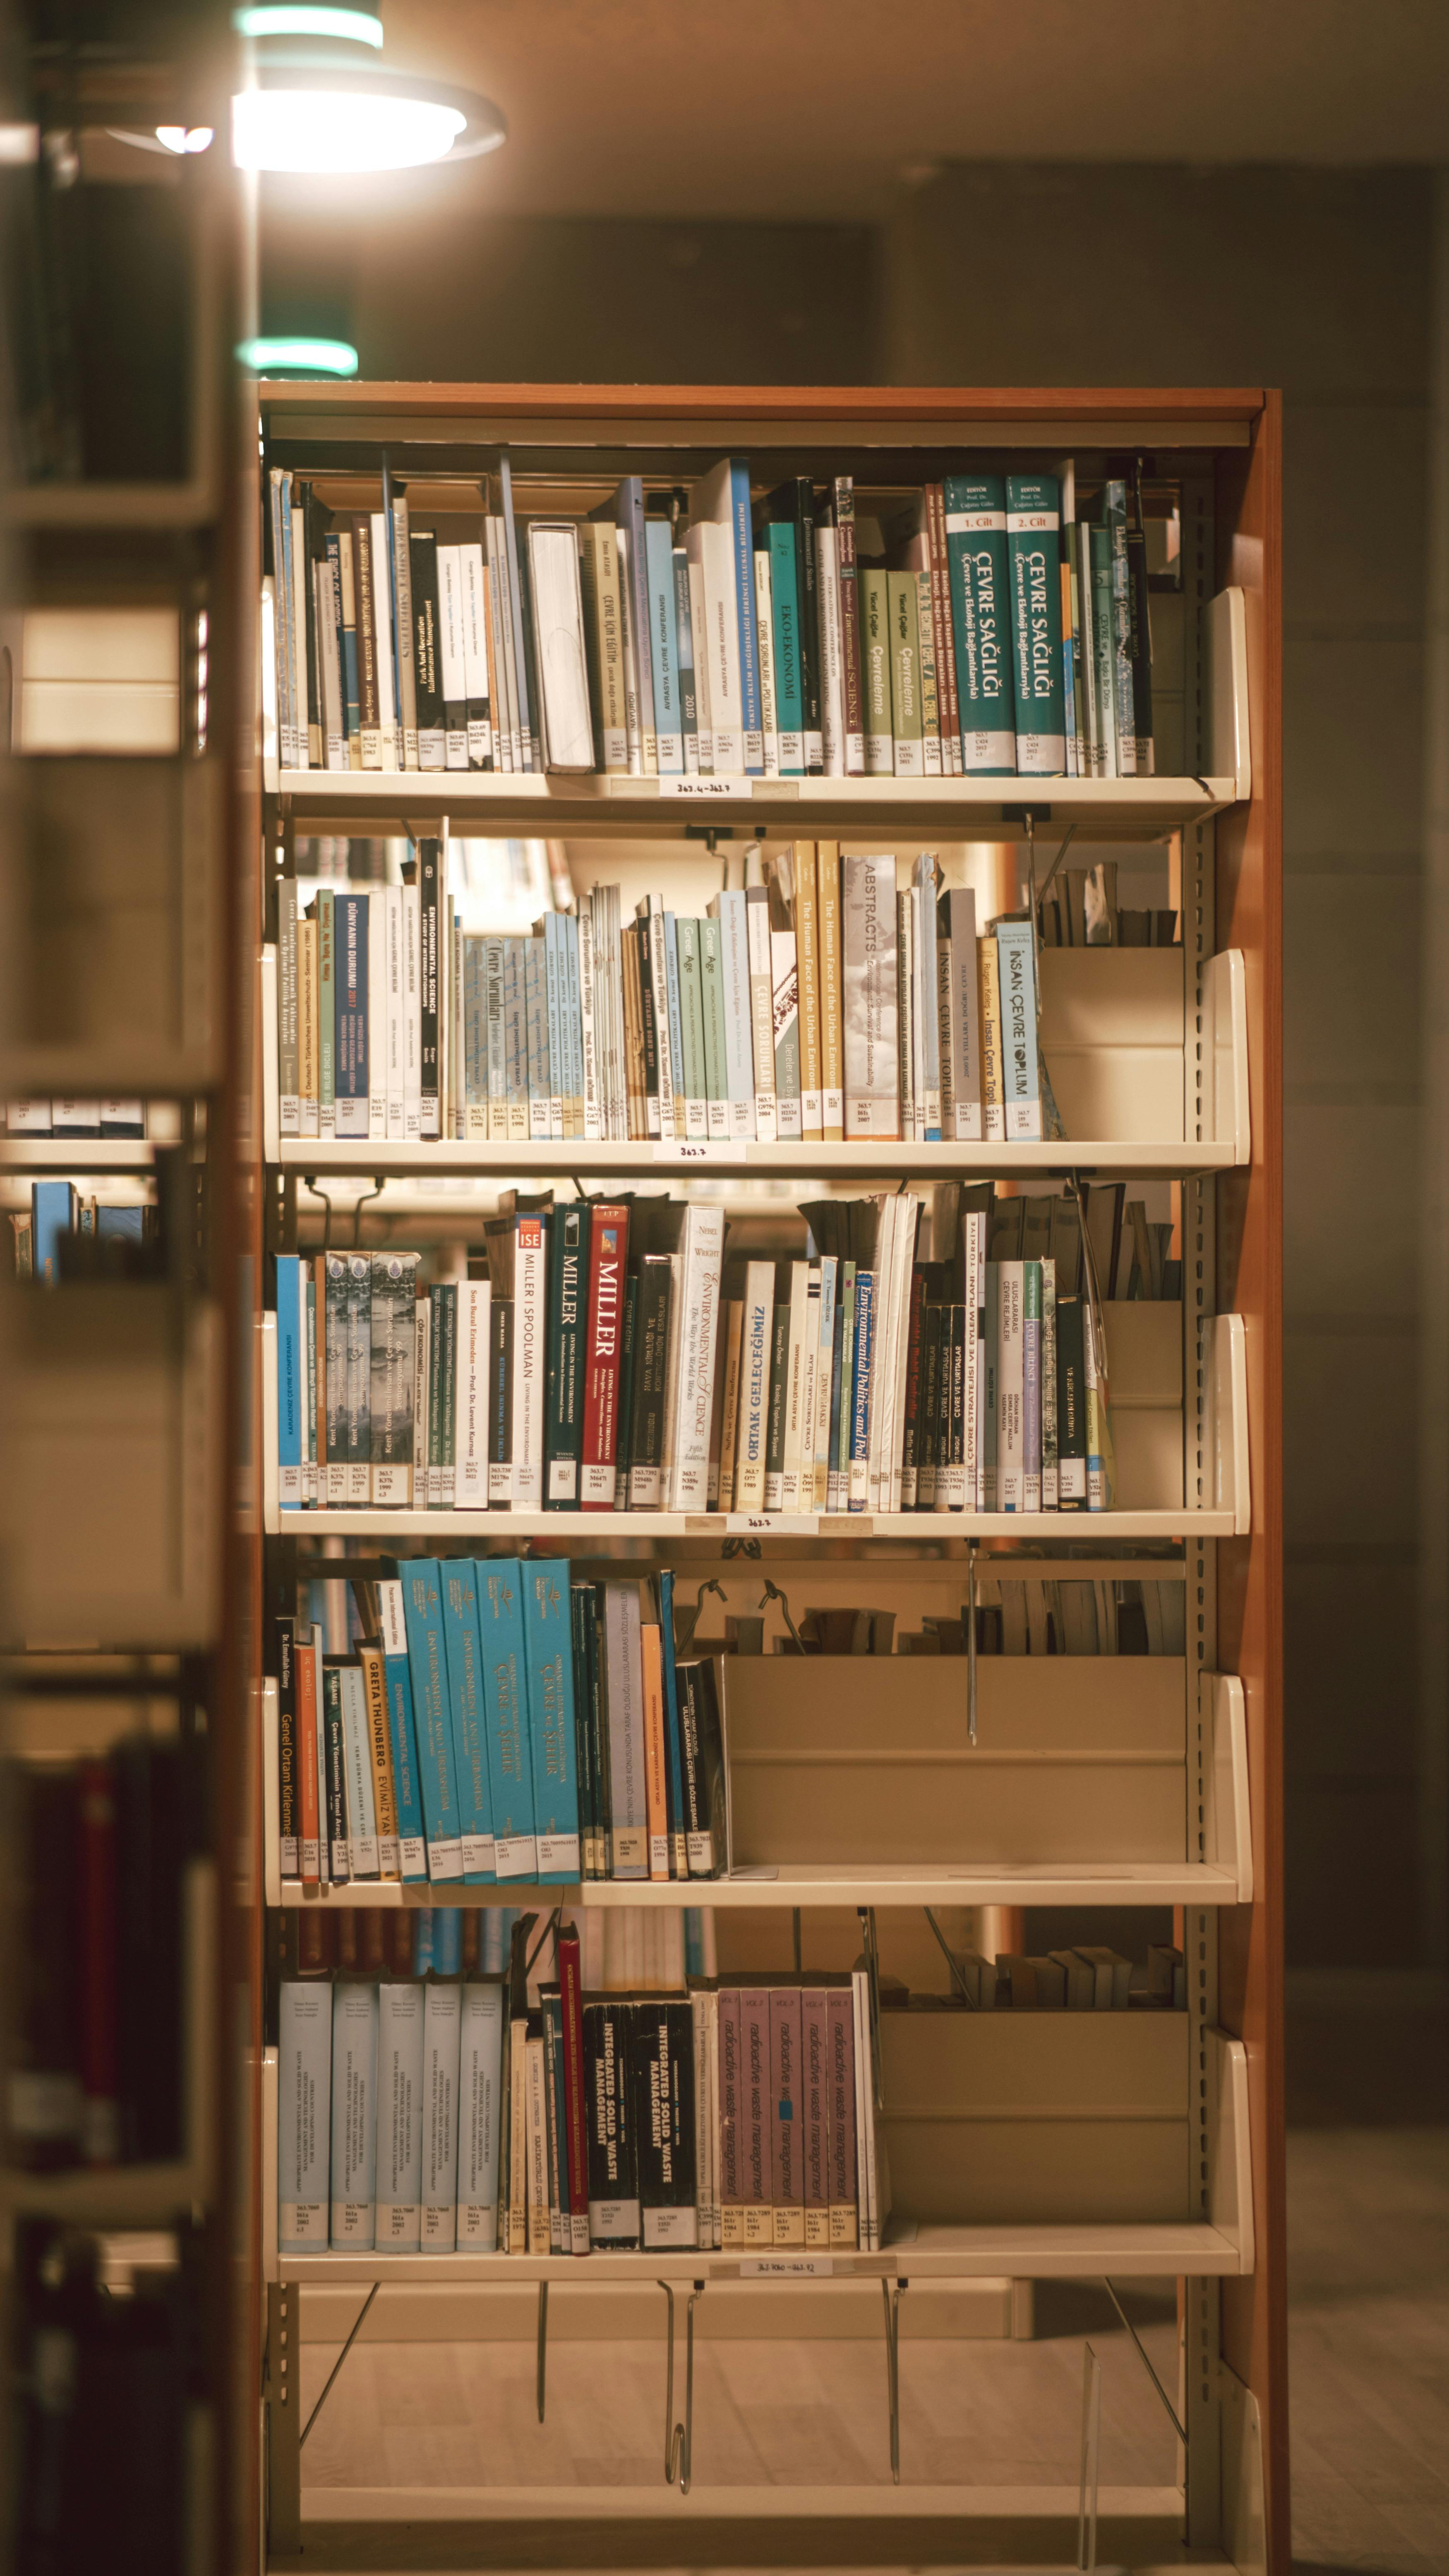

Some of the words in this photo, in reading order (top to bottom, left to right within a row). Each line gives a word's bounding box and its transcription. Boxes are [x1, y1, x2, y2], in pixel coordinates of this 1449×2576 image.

[965, 519, 973, 527] 1.
[976, 517, 993, 527] Cilt
[1018, 518, 1027, 527] 2.
[1029, 517, 1046, 527] Cilt
[961, 553, 975, 583] (Çevre
[972, 552, 995, 613] ÇEVRE
[1015, 553, 1027, 583] (Çevre
[1025, 552, 1047, 613] ÇEVRE
[603, 596, 615, 617] ÇEVRE
[870, 592, 878, 611] Yücel
[964, 586, 972, 596] ve
[1017, 586, 1024, 596] ve
[605, 621, 617, 636] İÇİN
[759, 621, 768, 641] ÇEVRE
[869, 614, 879, 638] Çağlar
[964, 599, 977, 629] Ekoloji
[1017, 599, 1028, 629] Ekoloji
[606, 638, 618, 663] EĞİTİM
[781, 605, 797, 699] EKO-EKONOMİ
[845, 613, 856, 669] Environmental
[980, 618, 1003, 698] SAĞLIĞI
[1032, 618, 1054, 698] SAĞLIĞI
[661, 647, 669, 672] ÇEVRE
[761, 644, 770, 680] SORUNLARI
[966, 631, 979, 699] Bağlantılarıyla)
[1018, 631, 1030, 699] Bağlantılarıyla)
[607, 684, 616, 698] doğa
[870, 646, 885, 714] Çevreleme
[608, 699, 618, 727] etkileşimi
[685, 695, 695, 718] 2010
[848, 672, 858, 727] SCIENCE
[348, 903, 358, 948] DÜNYANIN
[581, 914, 591, 937] Çevre
[803, 901, 812, 918] The
[864, 864, 877, 952] ABSTRACTS
[583, 939, 591, 973] Sorunları
[804, 922, 813, 955] Human
[348, 951, 357, 988] DURUMU
[584, 976, 590, 984] ve
[940, 953, 952, 994] İNSAN
[983, 963, 991, 986] Ruşen
[1010, 951, 1025, 990] İNSAN
[348, 989, 357, 1008] 2017
[583, 987, 593, 1014] Türkiye
[755, 986, 769, 1018] ÇEVRE
[806, 984, 814, 994] of
[983, 989, 992, 1008] Keleş
[807, 1015, 816, 1044] Urban
[939, 1005, 951, 1047] ÇEVRE
[985, 1020, 996, 1047] İnsan
[1010, 995, 1025, 1037] ÇEVRE
[758, 1027, 772, 1088] SORUNLARI
[984, 1050, 995, 1076] Çevre
[1014, 1042, 1027, 1094] TOPLUM
[681, 1147, 706, 1156] 363.7
[521, 1234, 540, 1247] ISE
[524, 1254, 535, 1297] MILLER
[562, 1255, 577, 1325] MILLER
[1002, 1281, 1010, 1301] ÇEVRE
[596, 1261, 619, 1356] MILLER
[1003, 1303, 1011, 1341] REJİMLERİ
[524, 1308, 535, 1378] SPOOLMAN
[858, 1284, 873, 1372] Environmental
[749, 1306, 765, 1407] GELECEĞİMİZ
[955, 1346, 963, 1385] YURTTAŞLAR
[968, 1349, 975, 1362] VE
[856, 1372, 868, 1413] Politics
[954, 1386, 961, 1395] VE
[967, 1366, 975, 1424] STRATEJİSİ
[748, 1412, 760, 1461] ORTAK
[856, 1416, 868, 1438] and
[967, 1426, 976, 1460] ÇEVRE
[281, 1670, 290, 1688] Güney
[329, 1676, 338, 1705] YAŞAMIŞ
[369, 1662, 380, 1698] GRETA
[281, 1714, 291, 1745] Genel
[372, 1704, 386, 1766] THUNBERG
[395, 1684, 408, 1763] ENVIRONMENTAL
[282, 1748, 293, 1782] Ortam
[378, 1776, 390, 1811] EVİMİZ
[401, 1767, 411, 1806] SCIENCE
[605, 2022, 614, 2095] INTEGRATED
[659, 2025, 669, 2098] INTEGRATED
[725, 2020, 737, 2080] radioactive
[750, 2023, 763, 2083] radioactive
[596, 2058, 607, 2145] MANAGEMENT
[606, 2099, 616, 2135] SOLID
[650, 2061, 661, 2148] MANAGEMENT
[726, 2086, 736, 2117] waste
[752, 2087, 762, 2120] waste
[661, 2102, 671, 2137] SOLID
[607, 2140, 617, 2180] WASTE
[662, 2142, 672, 2183] WASTE
[724, 2121, 739, 2197] management
[749, 2123, 765, 2199] management
